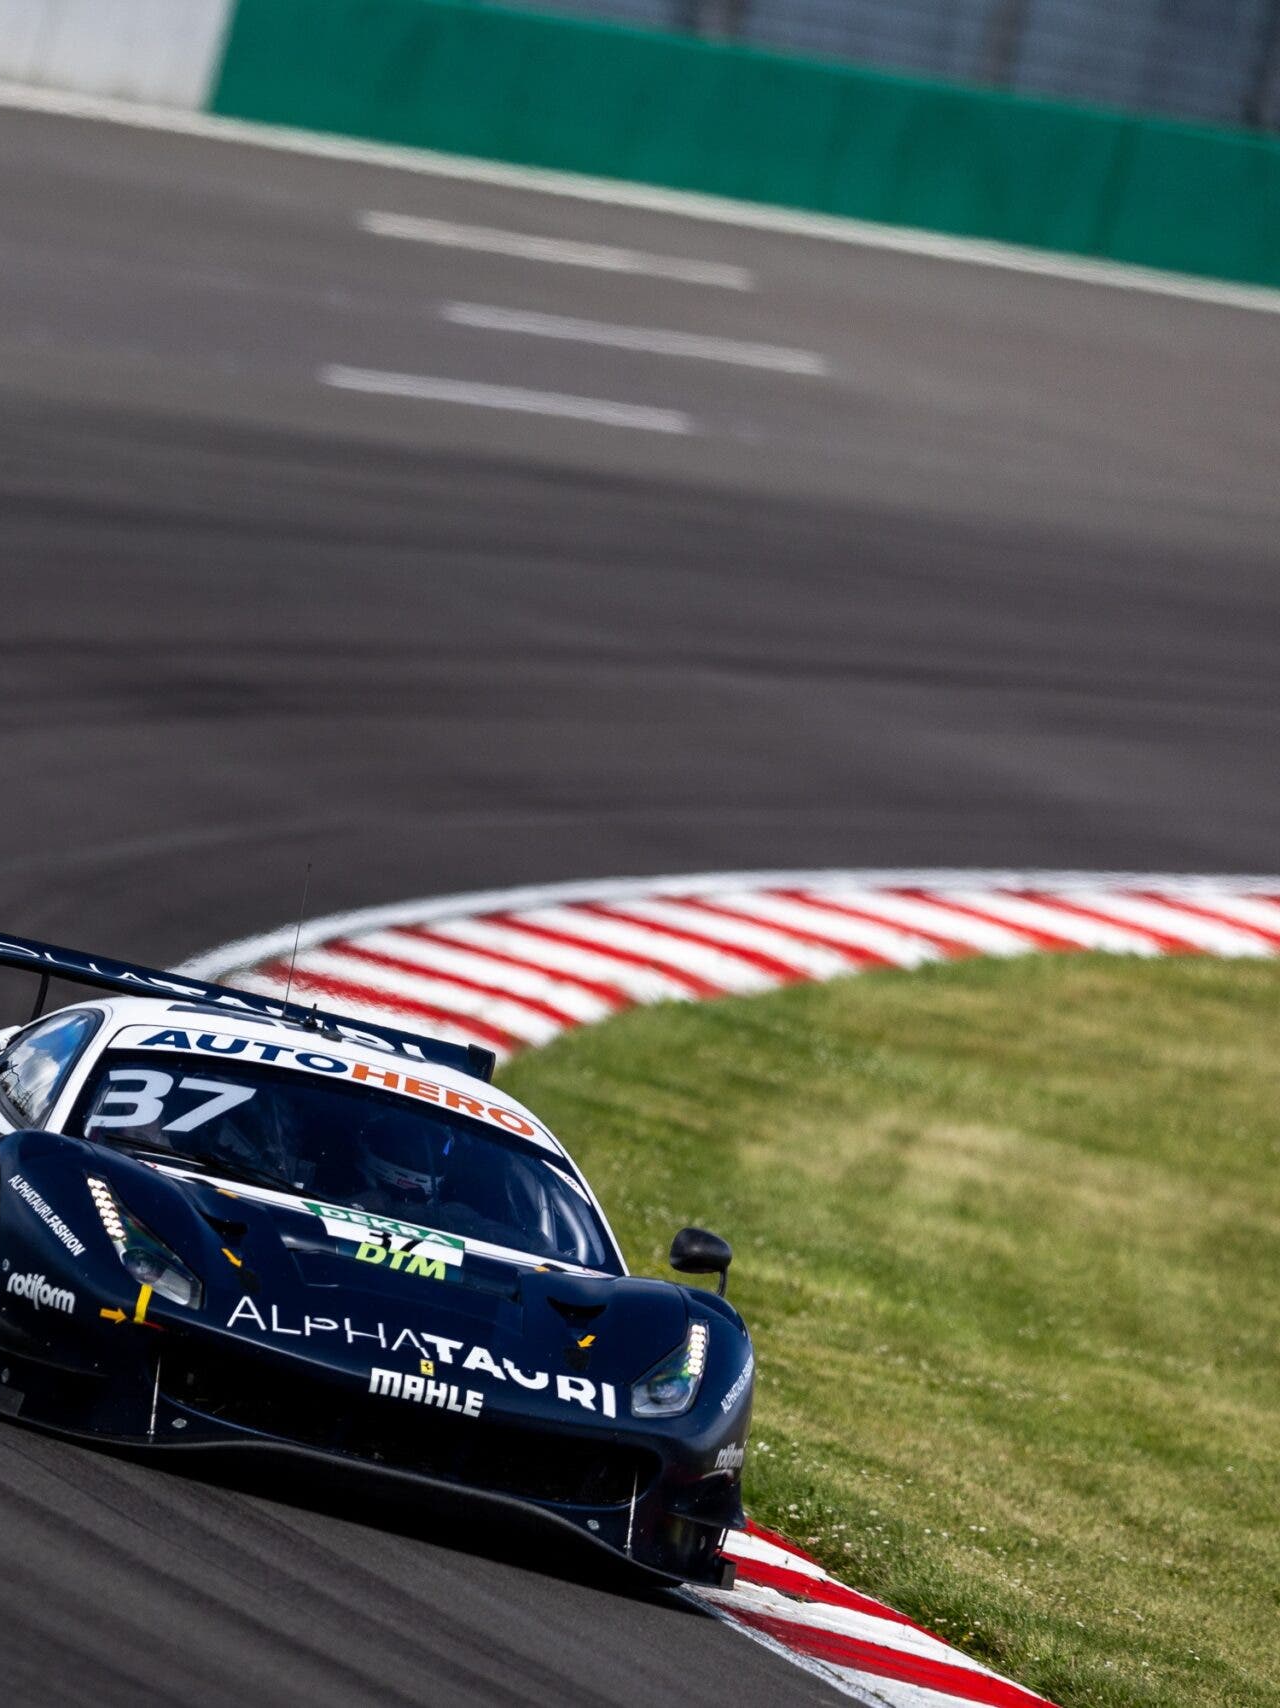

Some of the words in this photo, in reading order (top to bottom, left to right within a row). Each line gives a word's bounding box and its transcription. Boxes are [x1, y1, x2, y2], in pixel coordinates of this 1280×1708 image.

[84, 1069, 257, 1138] 37
[138, 1029, 536, 1137] AUTOHERO
[8, 1174, 87, 1257] ALPHATAURI.FASHION
[320, 1207, 454, 1247] DEKRA
[355, 1242, 446, 1281] DTM
[364, 1231, 424, 1253] 37
[6, 1272, 76, 1315] rotiform
[226, 1295, 617, 1419] ALPHATAURI
[368, 1367, 484, 1418] MAHLE
